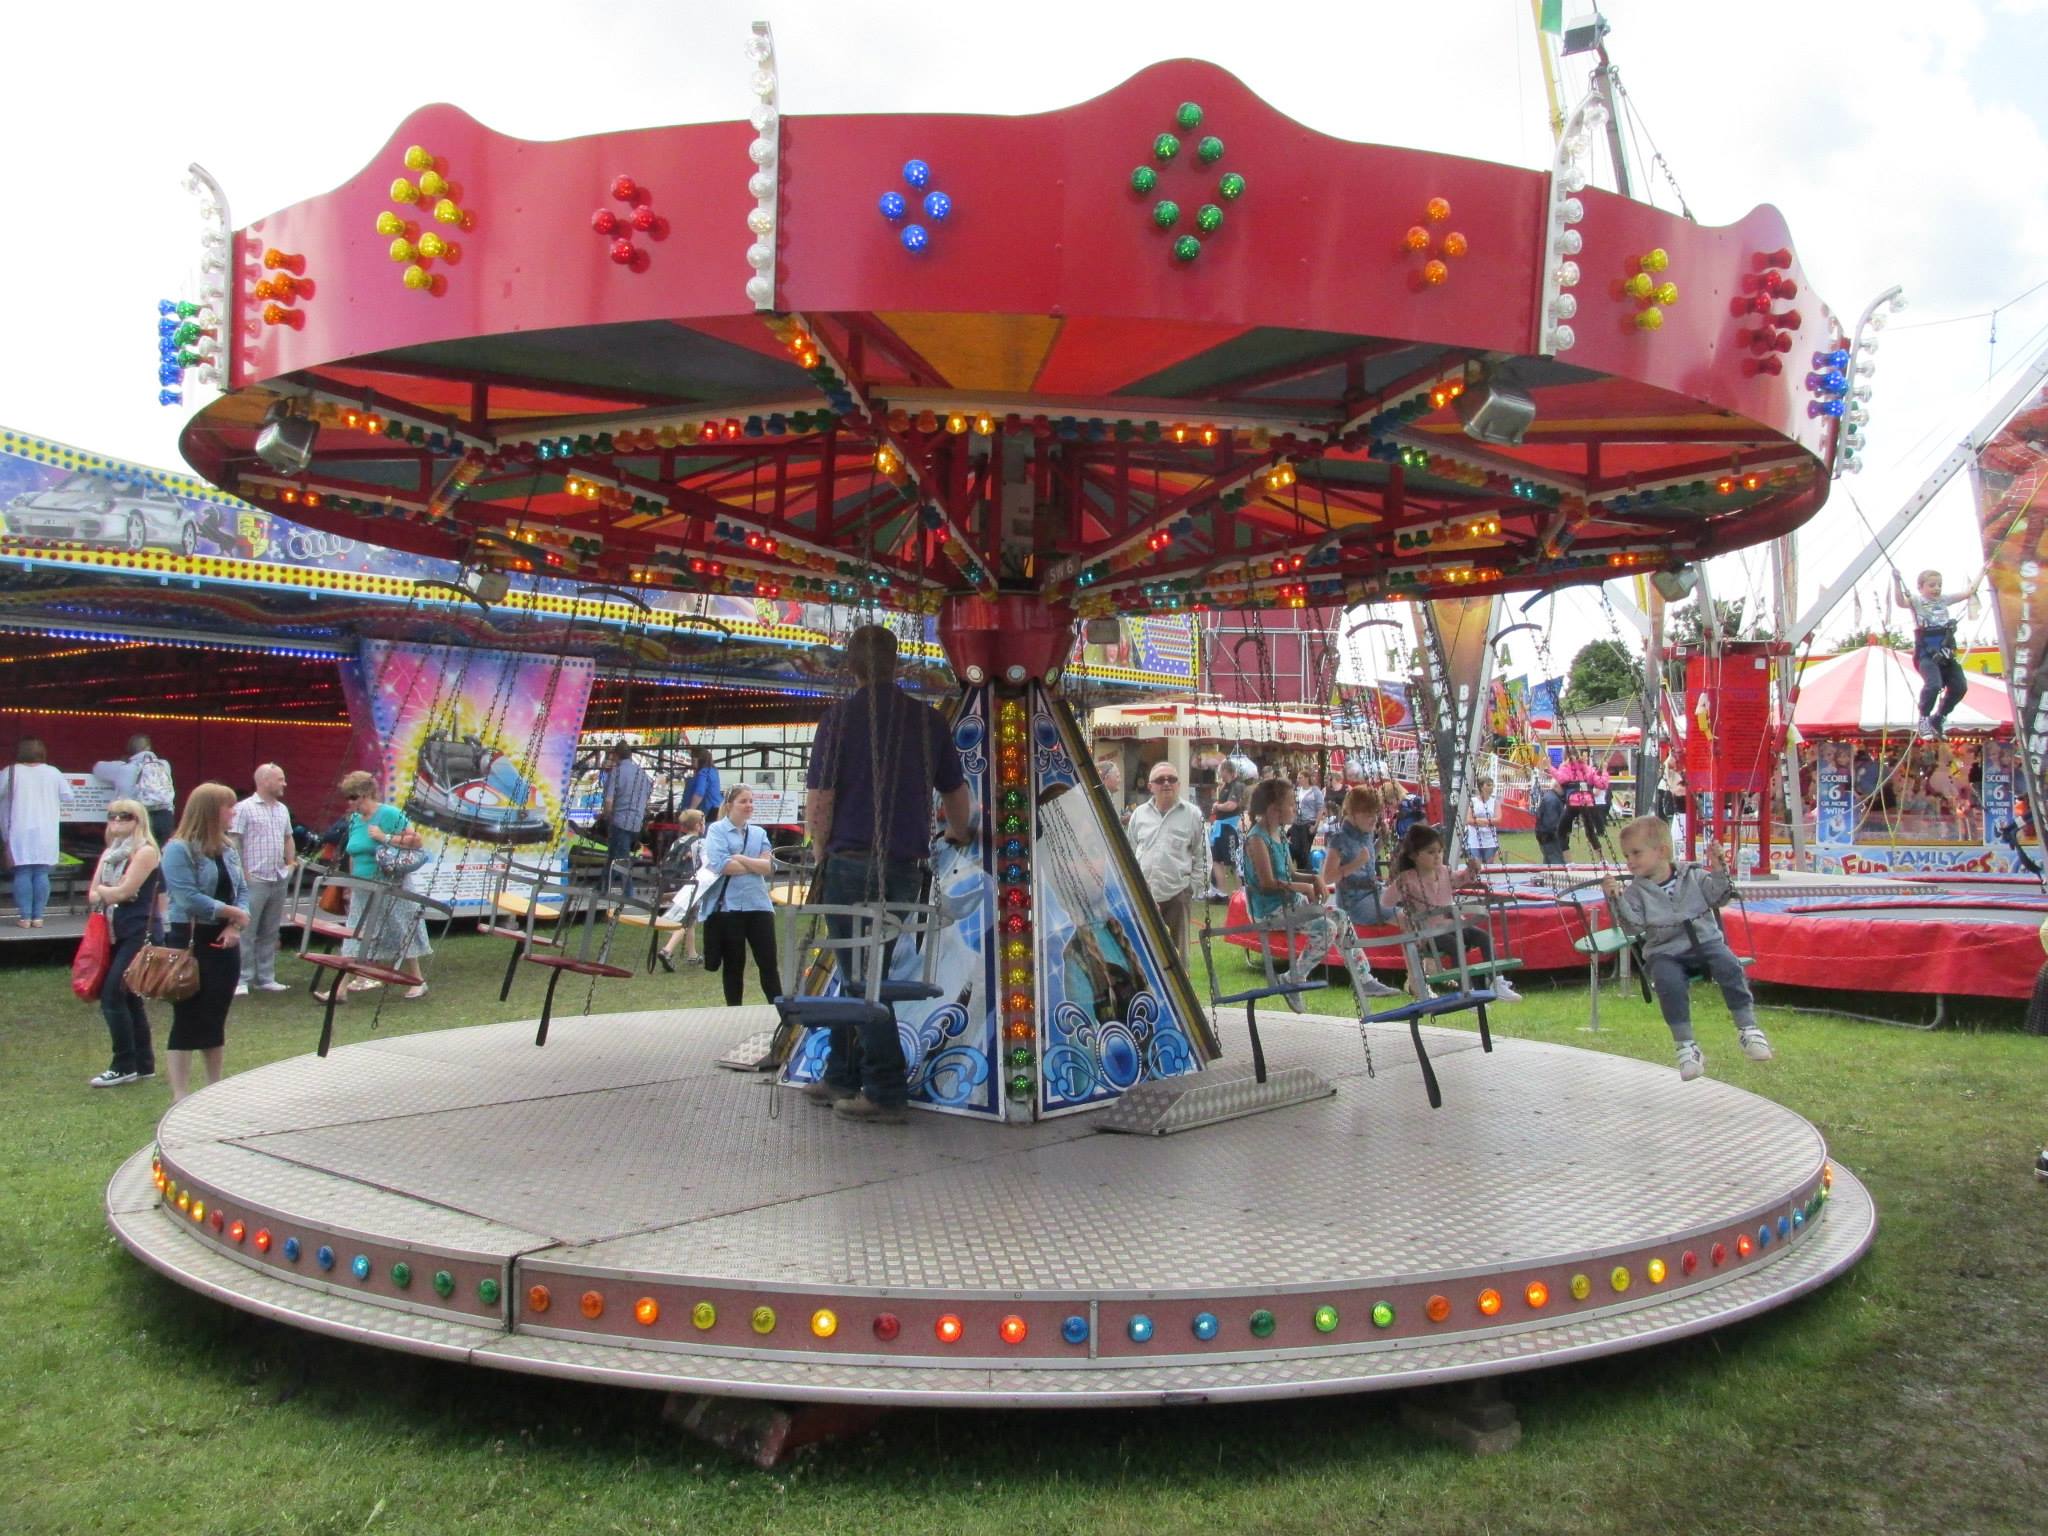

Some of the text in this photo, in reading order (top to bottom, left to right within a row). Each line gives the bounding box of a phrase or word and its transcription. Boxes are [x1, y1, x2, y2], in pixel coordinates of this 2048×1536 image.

[1163, 727, 1212, 737] HOT DRINKS
[1820, 774, 1849, 783] SCORE
[1986, 774, 2010, 783] SCORE
[1825, 807, 1845, 815] WIN
[1990, 807, 2008, 815] WIN
[1885, 850, 1965, 866] FAMILY
